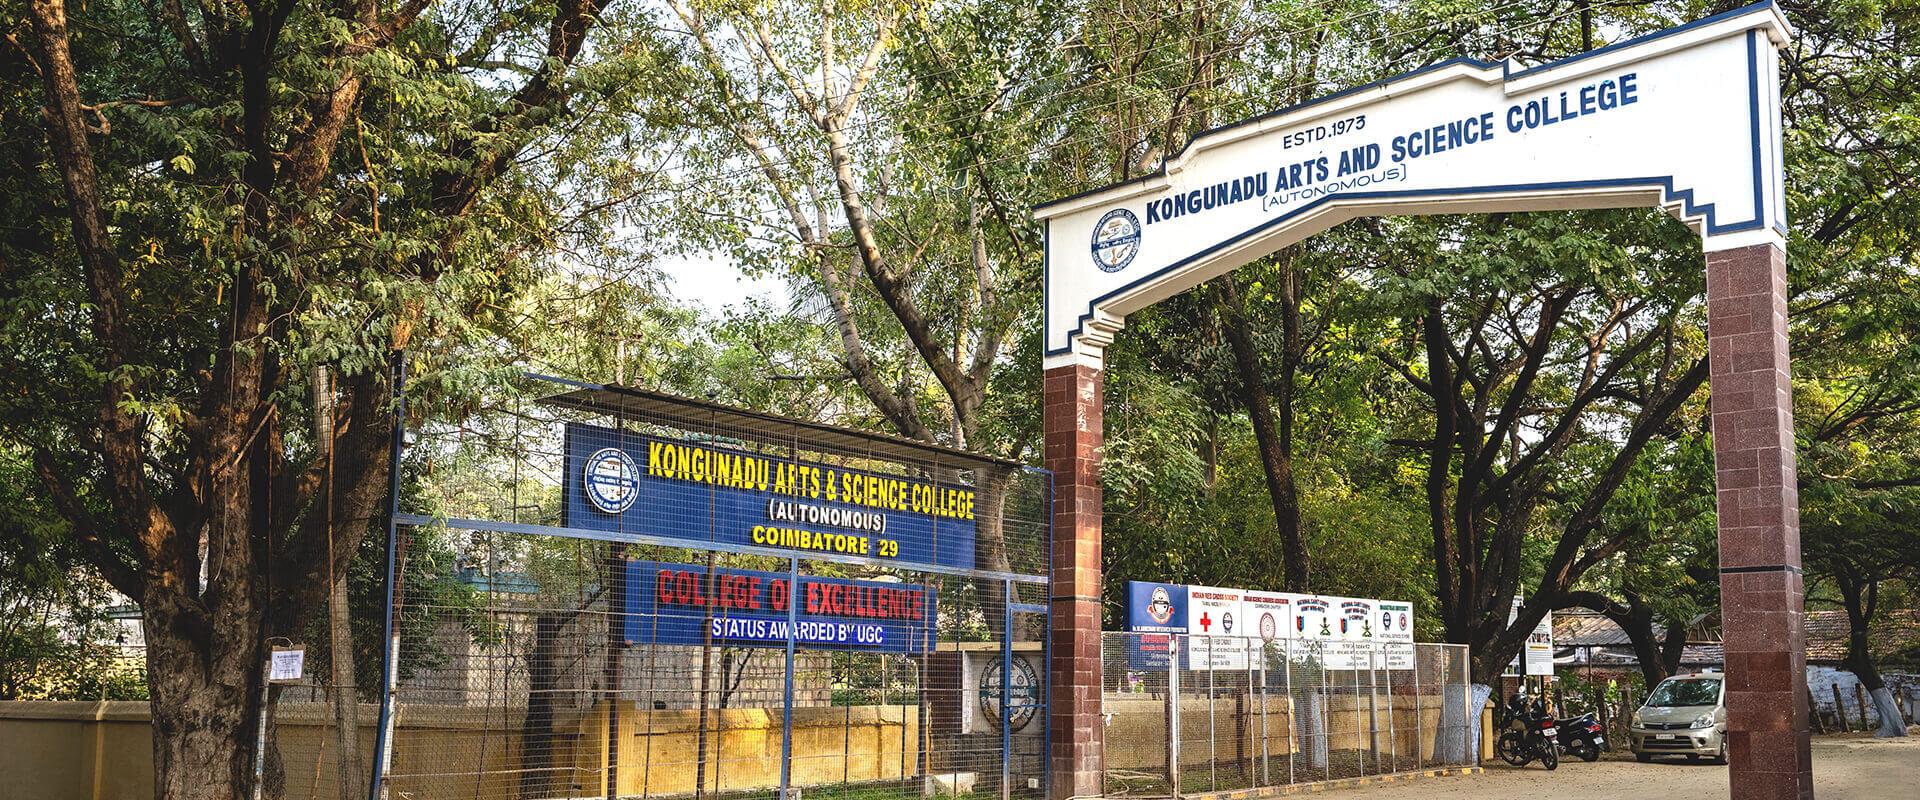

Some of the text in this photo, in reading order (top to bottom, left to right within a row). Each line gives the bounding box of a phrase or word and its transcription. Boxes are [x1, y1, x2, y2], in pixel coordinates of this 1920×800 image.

[1146, 172, 1268, 225] KONGUNADU
[1275, 156, 1329, 193] ARTS
[1337, 143, 1381, 178] AND
[1391, 112, 1494, 163] SCIENCE
[1506, 73, 1638, 133] COLLEGE
[1283, 115, 1366, 149] ESTD.1973
[649, 441, 769, 491] KONGUNADU
[774, 462, 820, 499] ARTS
[826, 470, 837, 501] &
[842, 472, 907, 511] SCIENCE
[912, 483, 975, 520] COLLEGE
[807, 582, 923, 620] EXCELLENCE
[712, 618, 883, 643] STATUS AWARDED BY UGC
